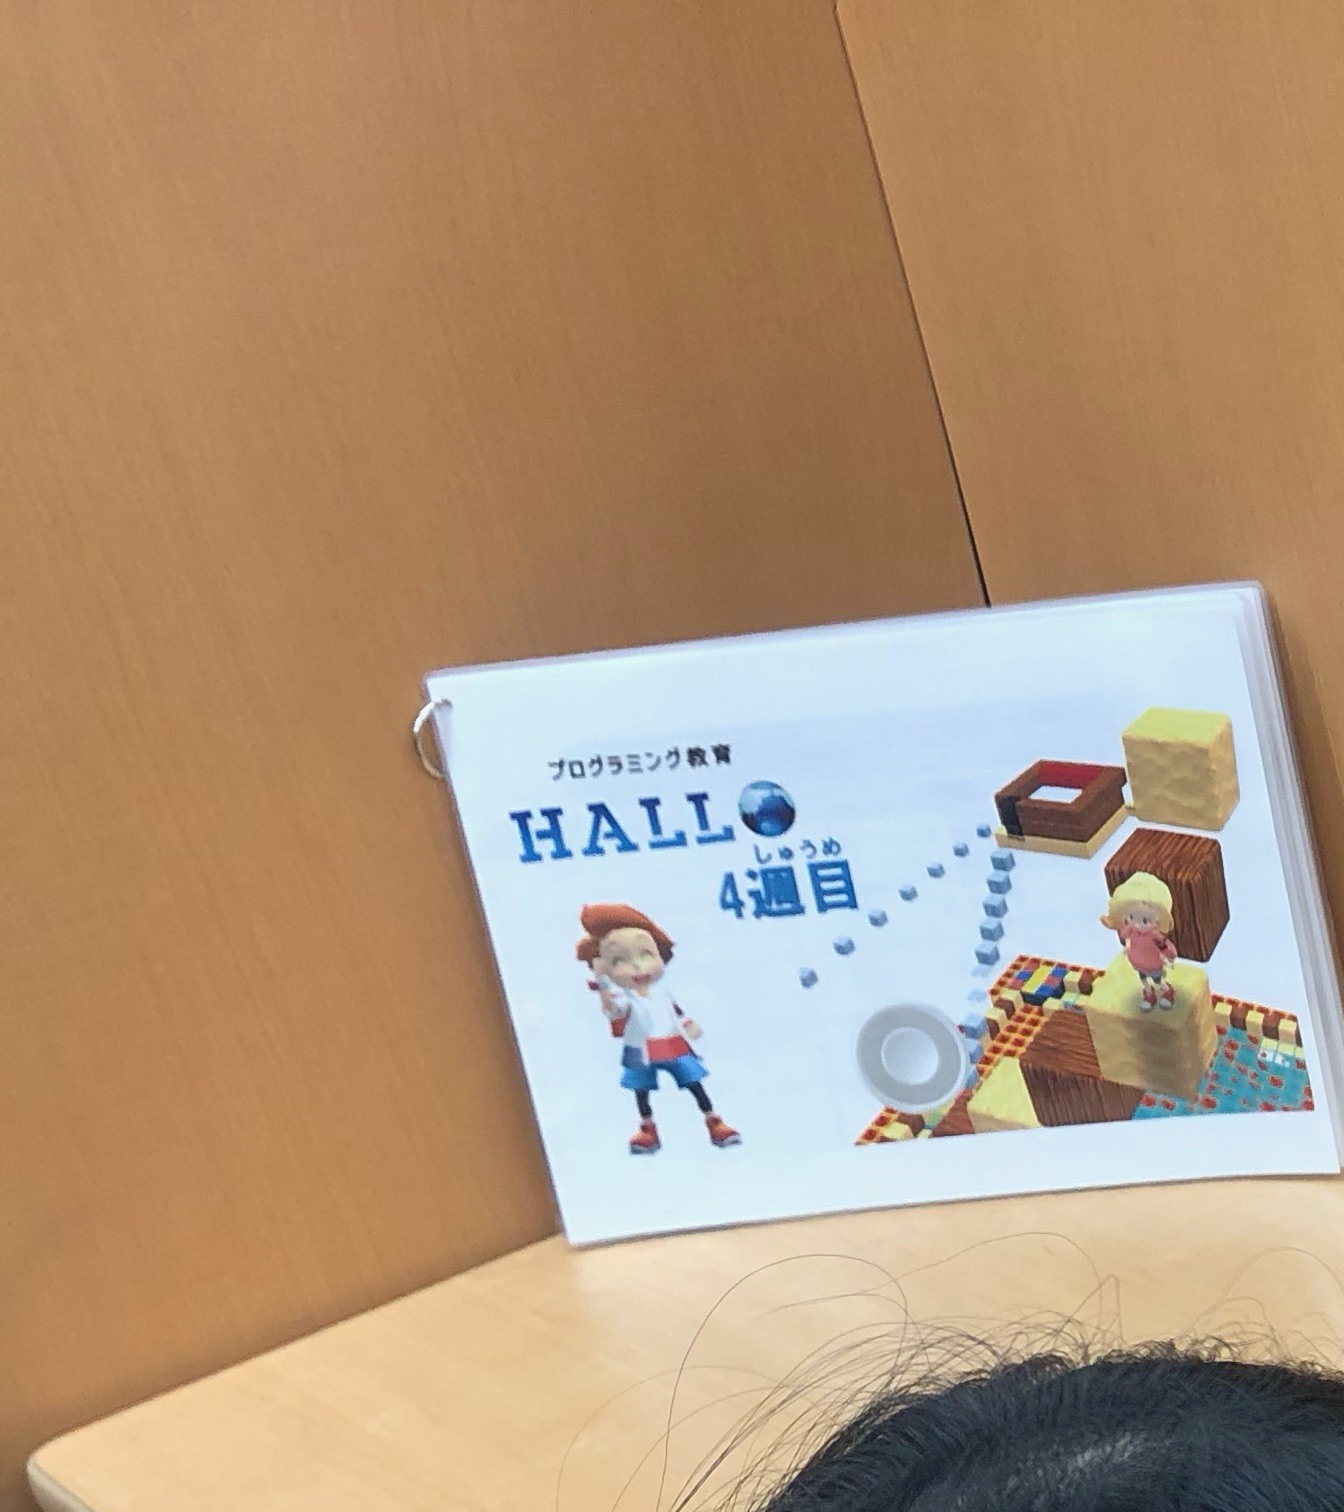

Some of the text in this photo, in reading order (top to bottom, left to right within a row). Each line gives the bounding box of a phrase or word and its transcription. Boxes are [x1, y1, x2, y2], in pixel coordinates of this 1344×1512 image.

[548, 743, 732, 781] プログラミング教育
[753, 837, 841, 864] しゅうめ
[719, 859, 858, 919] 4週目
